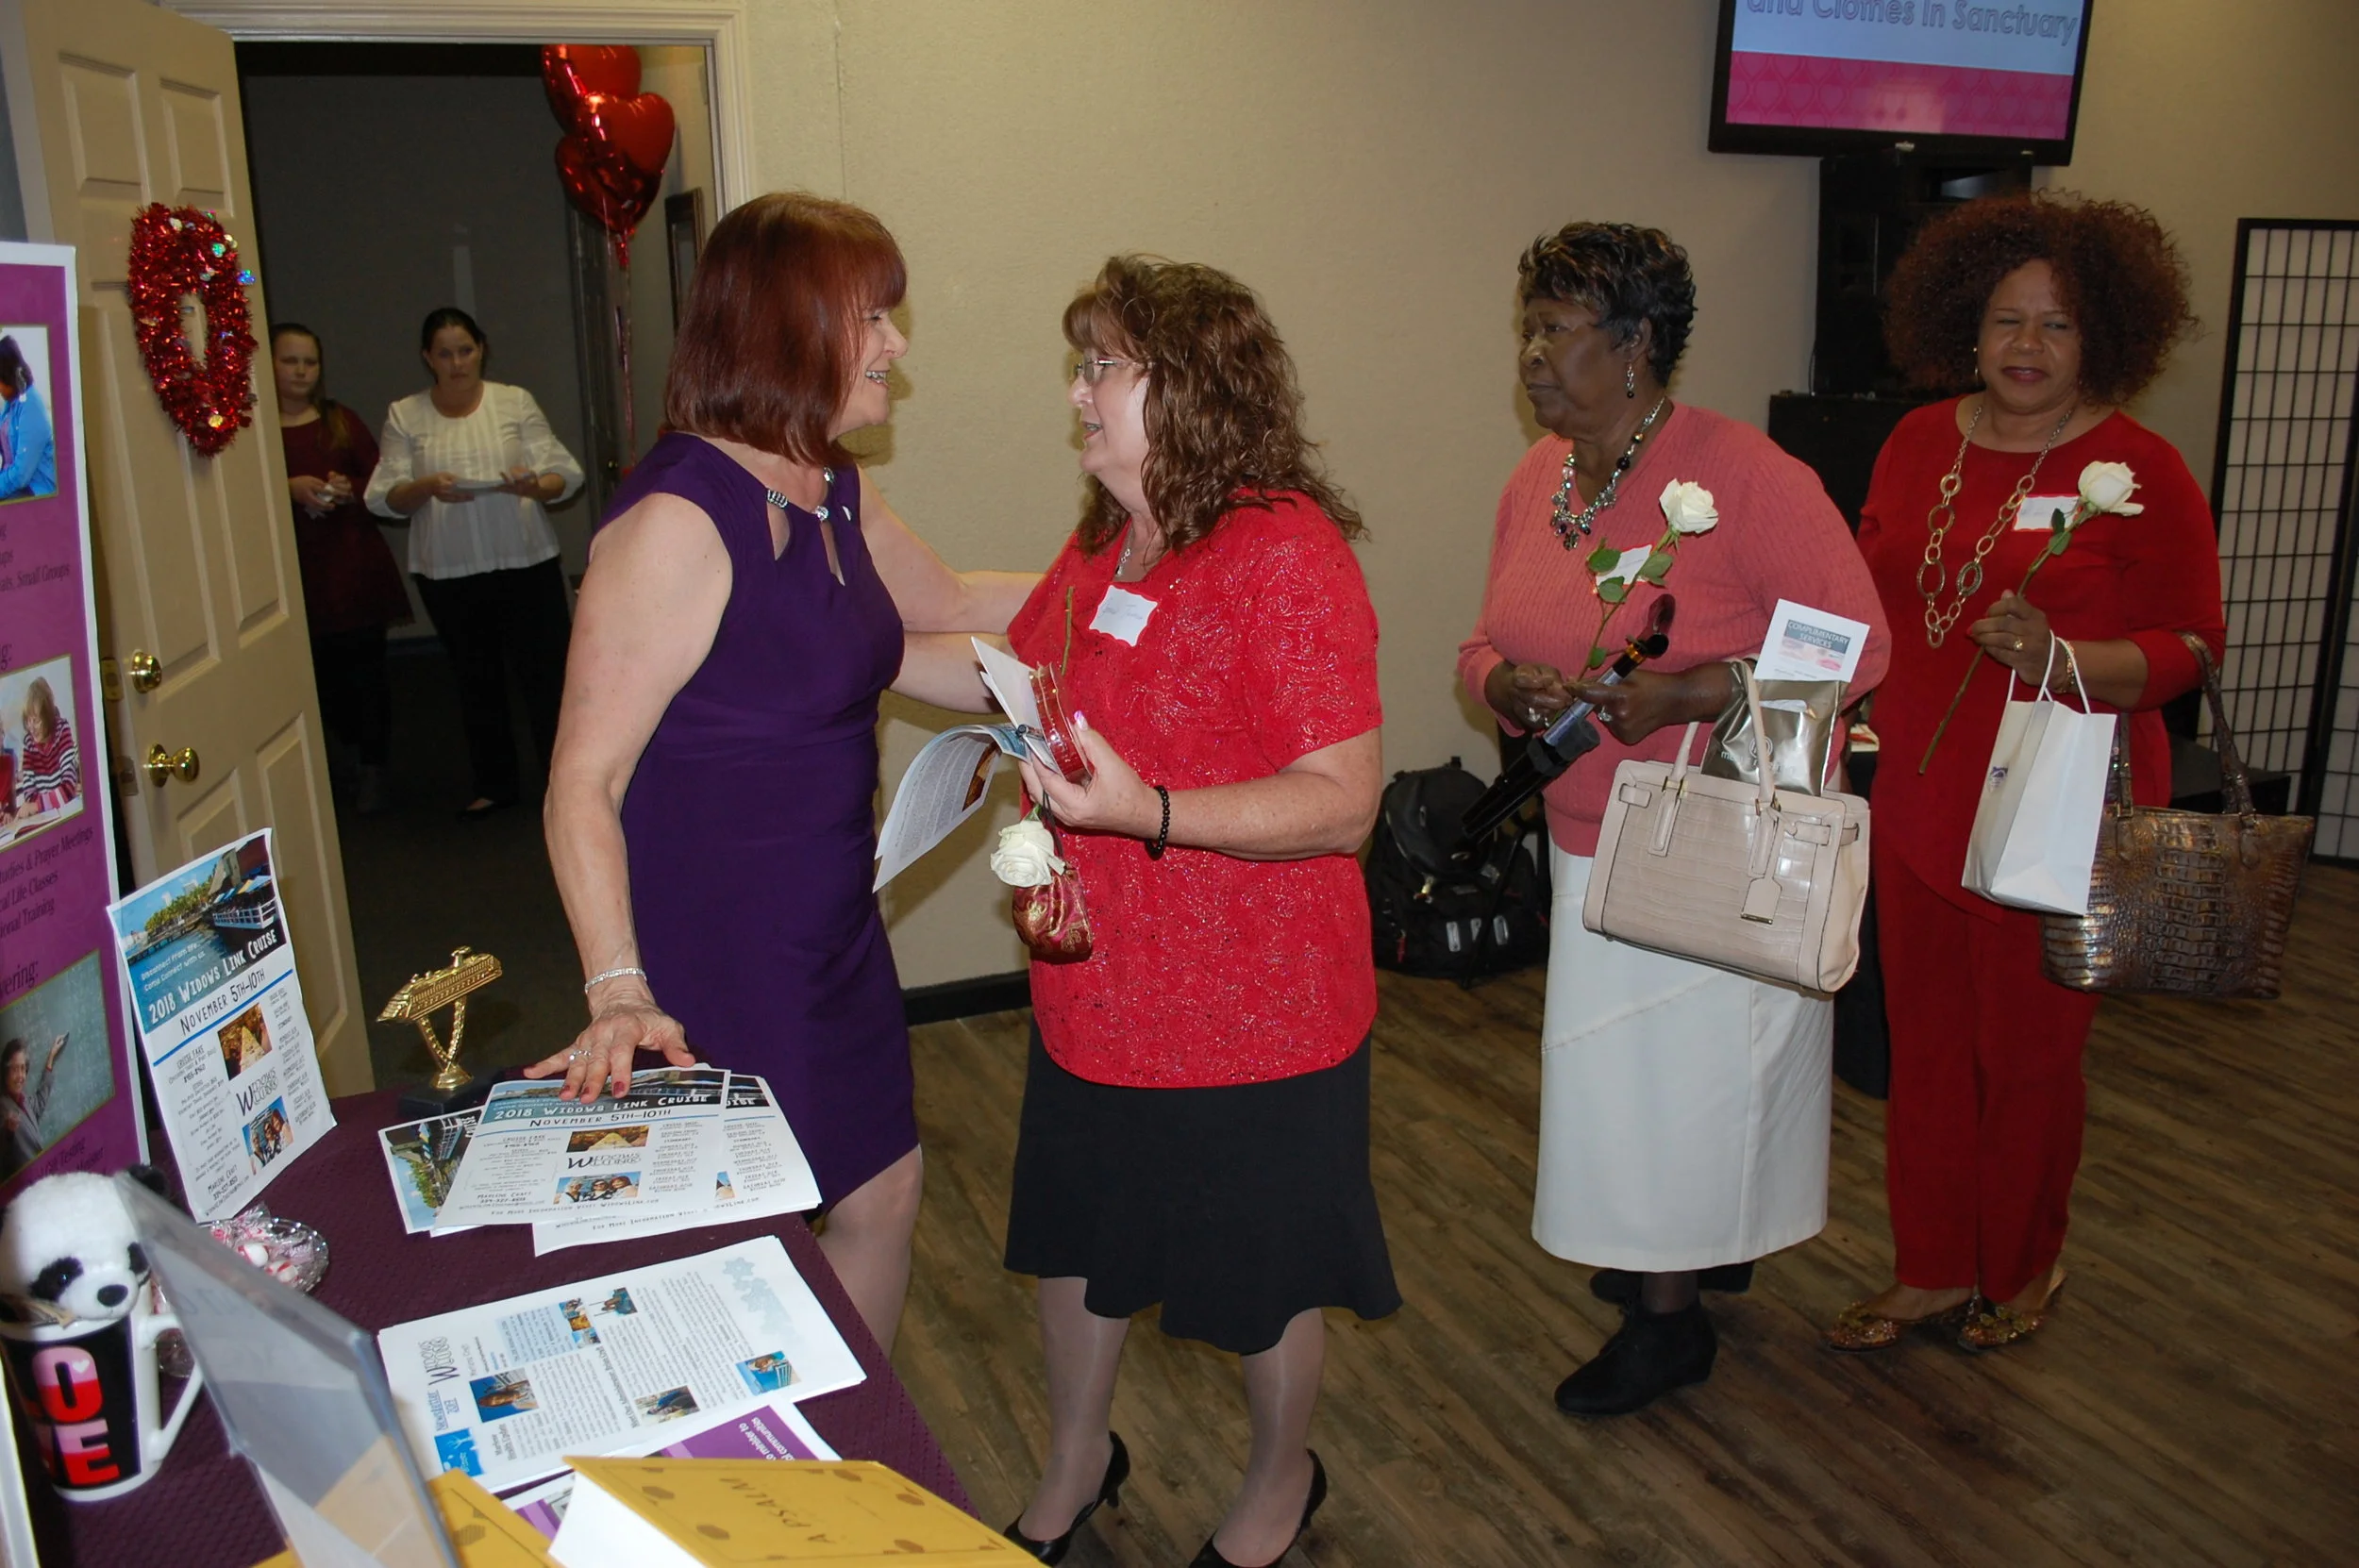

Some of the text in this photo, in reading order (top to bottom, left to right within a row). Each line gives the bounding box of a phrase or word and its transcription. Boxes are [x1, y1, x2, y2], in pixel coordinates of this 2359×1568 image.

[1952, 0, 2079, 47] Sanctuary
[1787, 622, 1849, 645] COMPLIMENTARY
[1799, 632, 1832, 648] SERVICES
[35, 842, 59, 866] Prayer
[60, 826, 93, 853] Meetings
[29, 870, 59, 894] Classes
[23, 898, 55, 925] Training
[149, 929, 277, 1024] 2018 WIDOWS LINK CRUISE
[179, 994, 228, 1037] NOVEMBER
[494, 1095, 709, 1120] 2018 WIDOWS LINK CRUISE
[529, 1116, 602, 1127] NOVEMBER
[25, 1345, 104, 1424] O
[427, 1390, 448, 1431] Newsletter
[35, 1418, 121, 1486] E
